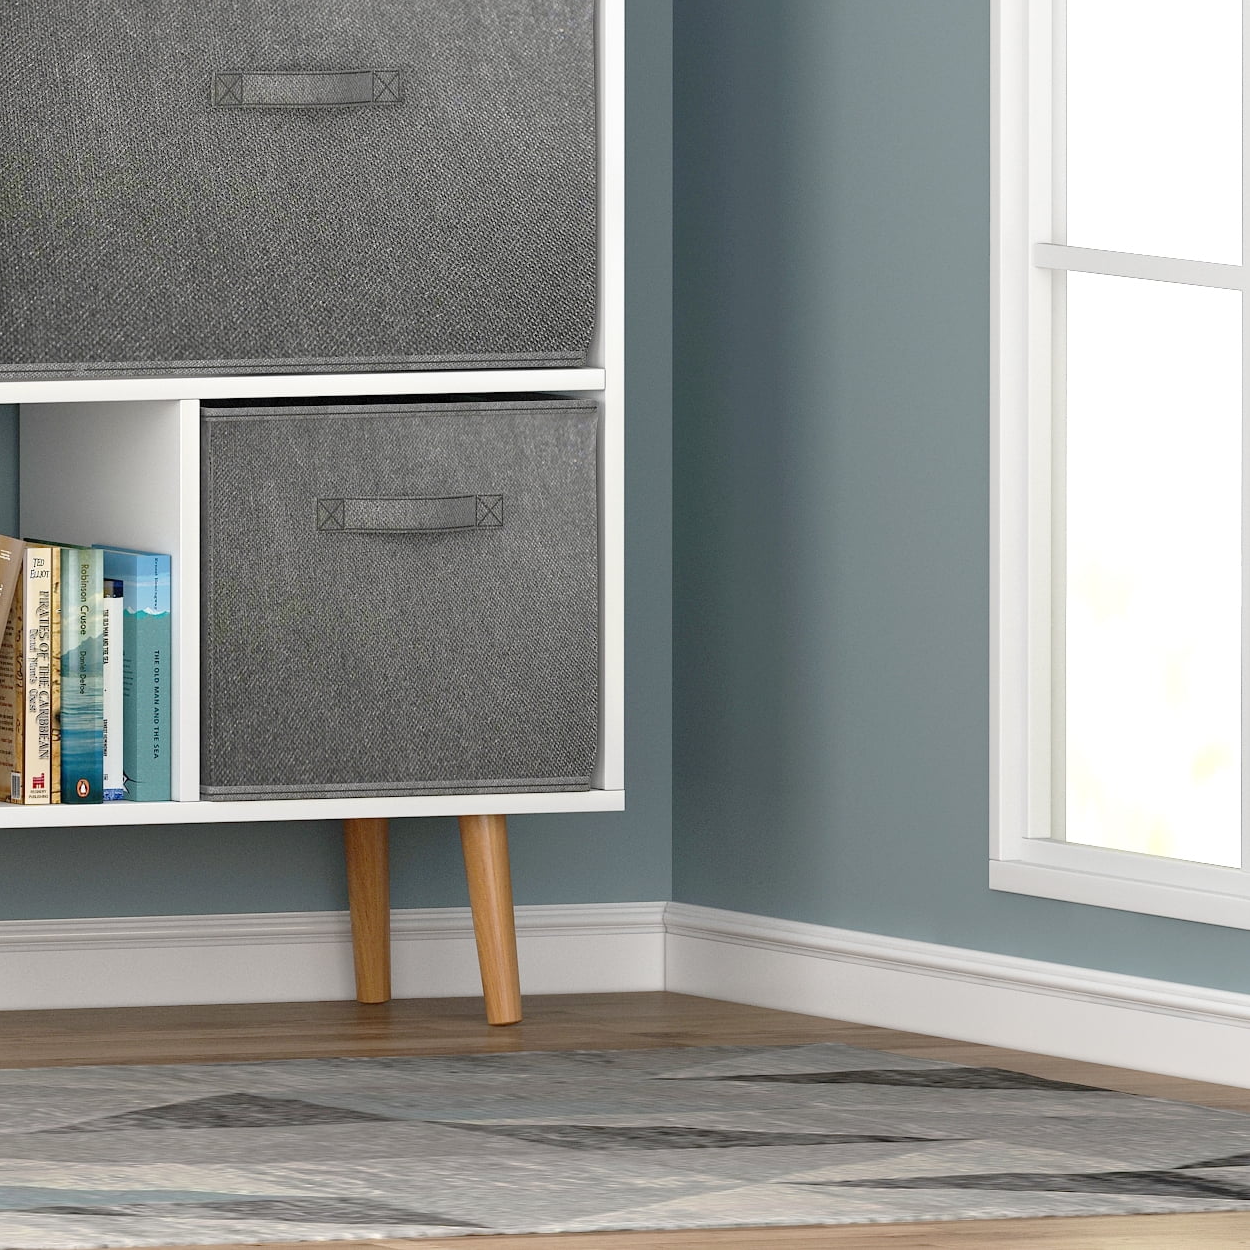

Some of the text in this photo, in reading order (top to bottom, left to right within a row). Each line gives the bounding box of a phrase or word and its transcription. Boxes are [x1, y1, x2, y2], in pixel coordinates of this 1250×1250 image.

[33, 558, 44, 567] TED
[80, 564, 89, 635] Robinson Crusoe
[36, 591, 49, 641] PIRATES
[37, 642, 49, 660] OF
[39, 663, 49, 688] THE
